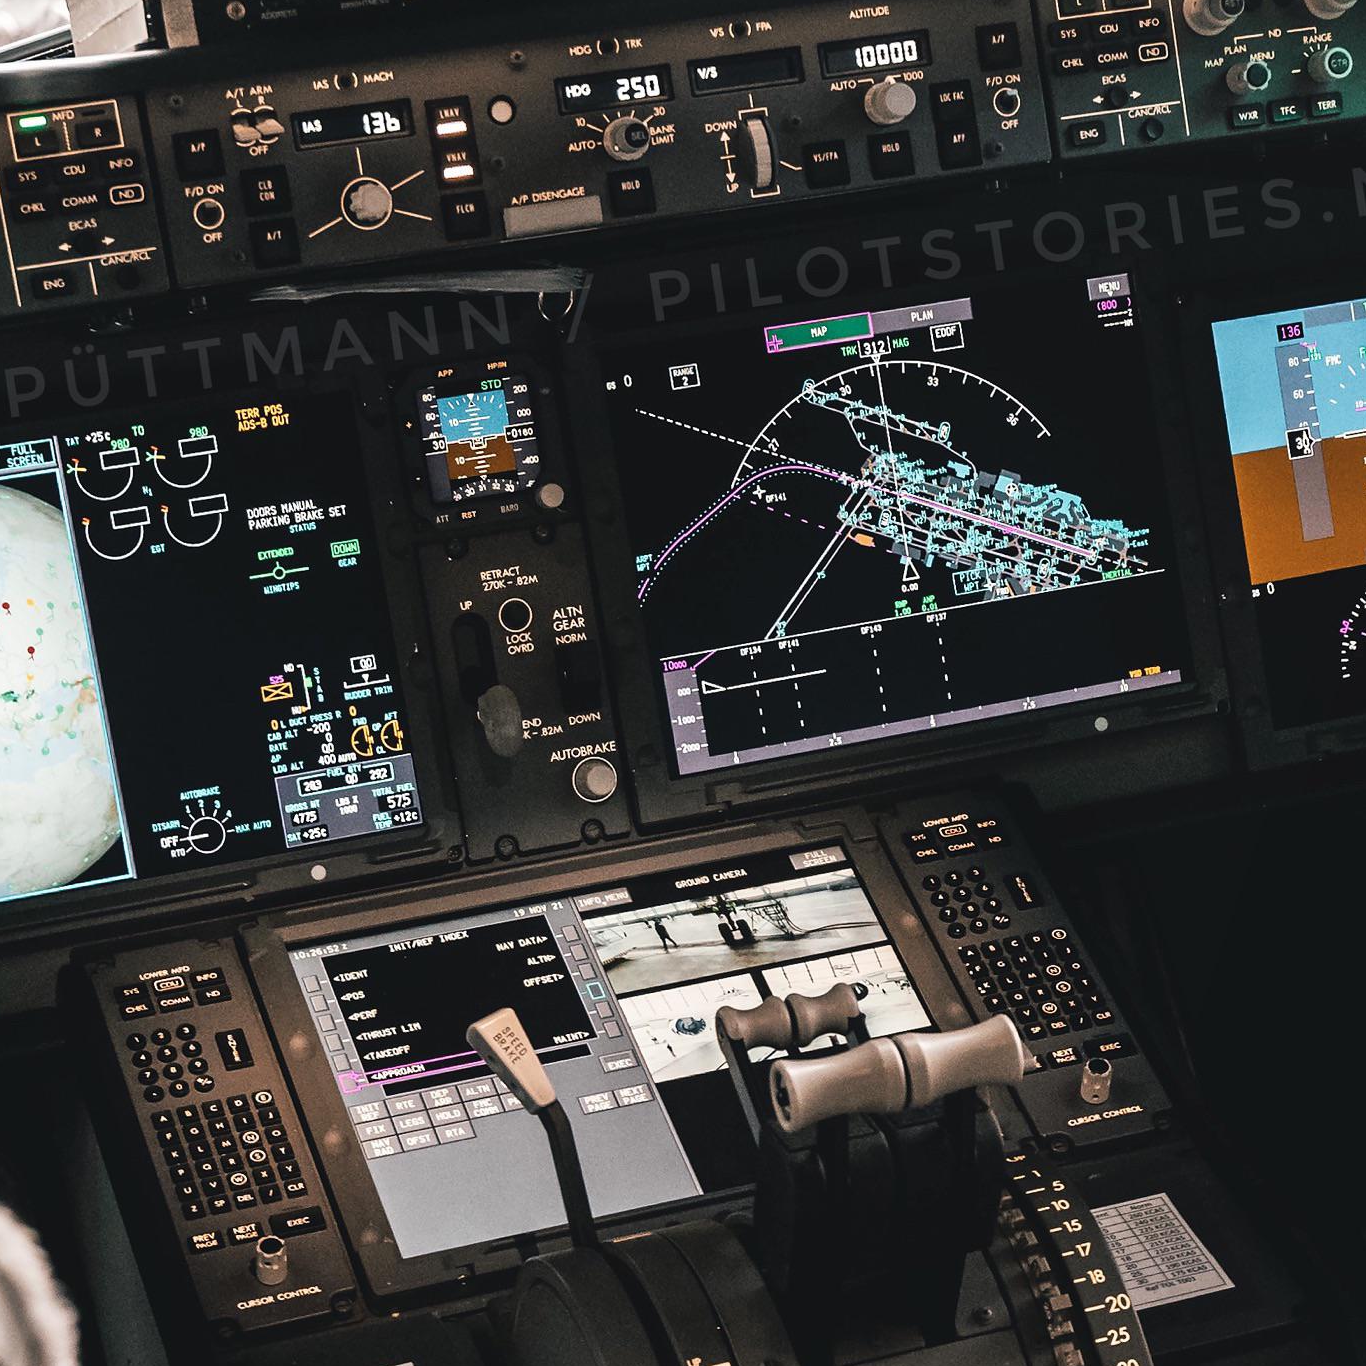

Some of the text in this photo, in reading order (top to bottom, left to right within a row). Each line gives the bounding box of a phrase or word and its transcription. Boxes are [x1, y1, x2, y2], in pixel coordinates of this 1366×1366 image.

[849, 6, 890, 19] ALTITUDE
[710, 21, 772, 37] V/S FPA
[569, 39, 643, 56] HDG TRK
[855, 39, 917, 68] 10000
[697, 66, 718, 79] V/S
[902, 70, 924, 81] 1000
[313, 72, 394, 90] IAS MACH
[565, 74, 660, 101] HDG 250
[986, 74, 1021, 87] F/D ON
[225, 84, 273, 99] A/T ARM
[362, 110, 401, 135] 136
[1239, 109, 1259, 122] WXR
[302, 120, 322, 133] IAS
[650, 124, 676, 136] BANK
[568, 140, 595, 152] AUTO
[651, 134, 675, 145] LIMIT
[249, 146, 268, 156] OFF
[63, 165, 86, 176] CDU
[109, 158, 134, 169] INFO
[18, 171, 37, 181] SYS
[185, 183, 224, 197] F/D ON
[511, 187, 585, 205] A/P DISENGAGE
[20, 202, 46, 213] CHKL
[62, 194, 98, 207] COMM
[68, 218, 97, 231] EICAS
[203, 232, 223, 243] OFF
[43, 278, 66, 289] ENG
[1098, 278, 1120, 293] MENU
[910, 308, 934, 323] PLAN
[810, 324, 829, 339] MAP
[934, 326, 958, 340] EDDF
[841, 336, 910, 357] TRK 312 MAG
[480, 378, 501, 391] STD
[236, 404, 283, 421] TERR POS
[238, 413, 290, 432] ADS-B OUT
[247, 499, 317, 520] DOORS MANUAL
[248, 503, 347, 530] PARKING BRAKE SET
[480, 566, 521, 581] RETRACT
[552, 605, 583, 620] ALTN
[553, 616, 585, 632] GEAR
[555, 632, 587, 645] NORM
[550, 741, 616, 763] AUTOBRAKE
[675, 869, 747, 889] GROUND CAMERA
[388, 930, 469, 953] INIT/REF INDEX
[496, 940, 516, 952] NAV
[139, 965, 190, 981] LOWER MFD
[501, 1026, 528, 1056] SPEED
[492, 1033, 521, 1065] BRAKE
[1086, 1268, 1106, 1285] 18
[236, 1285, 322, 1310] CURSOR CONTROL
[1104, 1293, 1132, 1312] 20
[1108, 1327, 1131, 1345] 25
